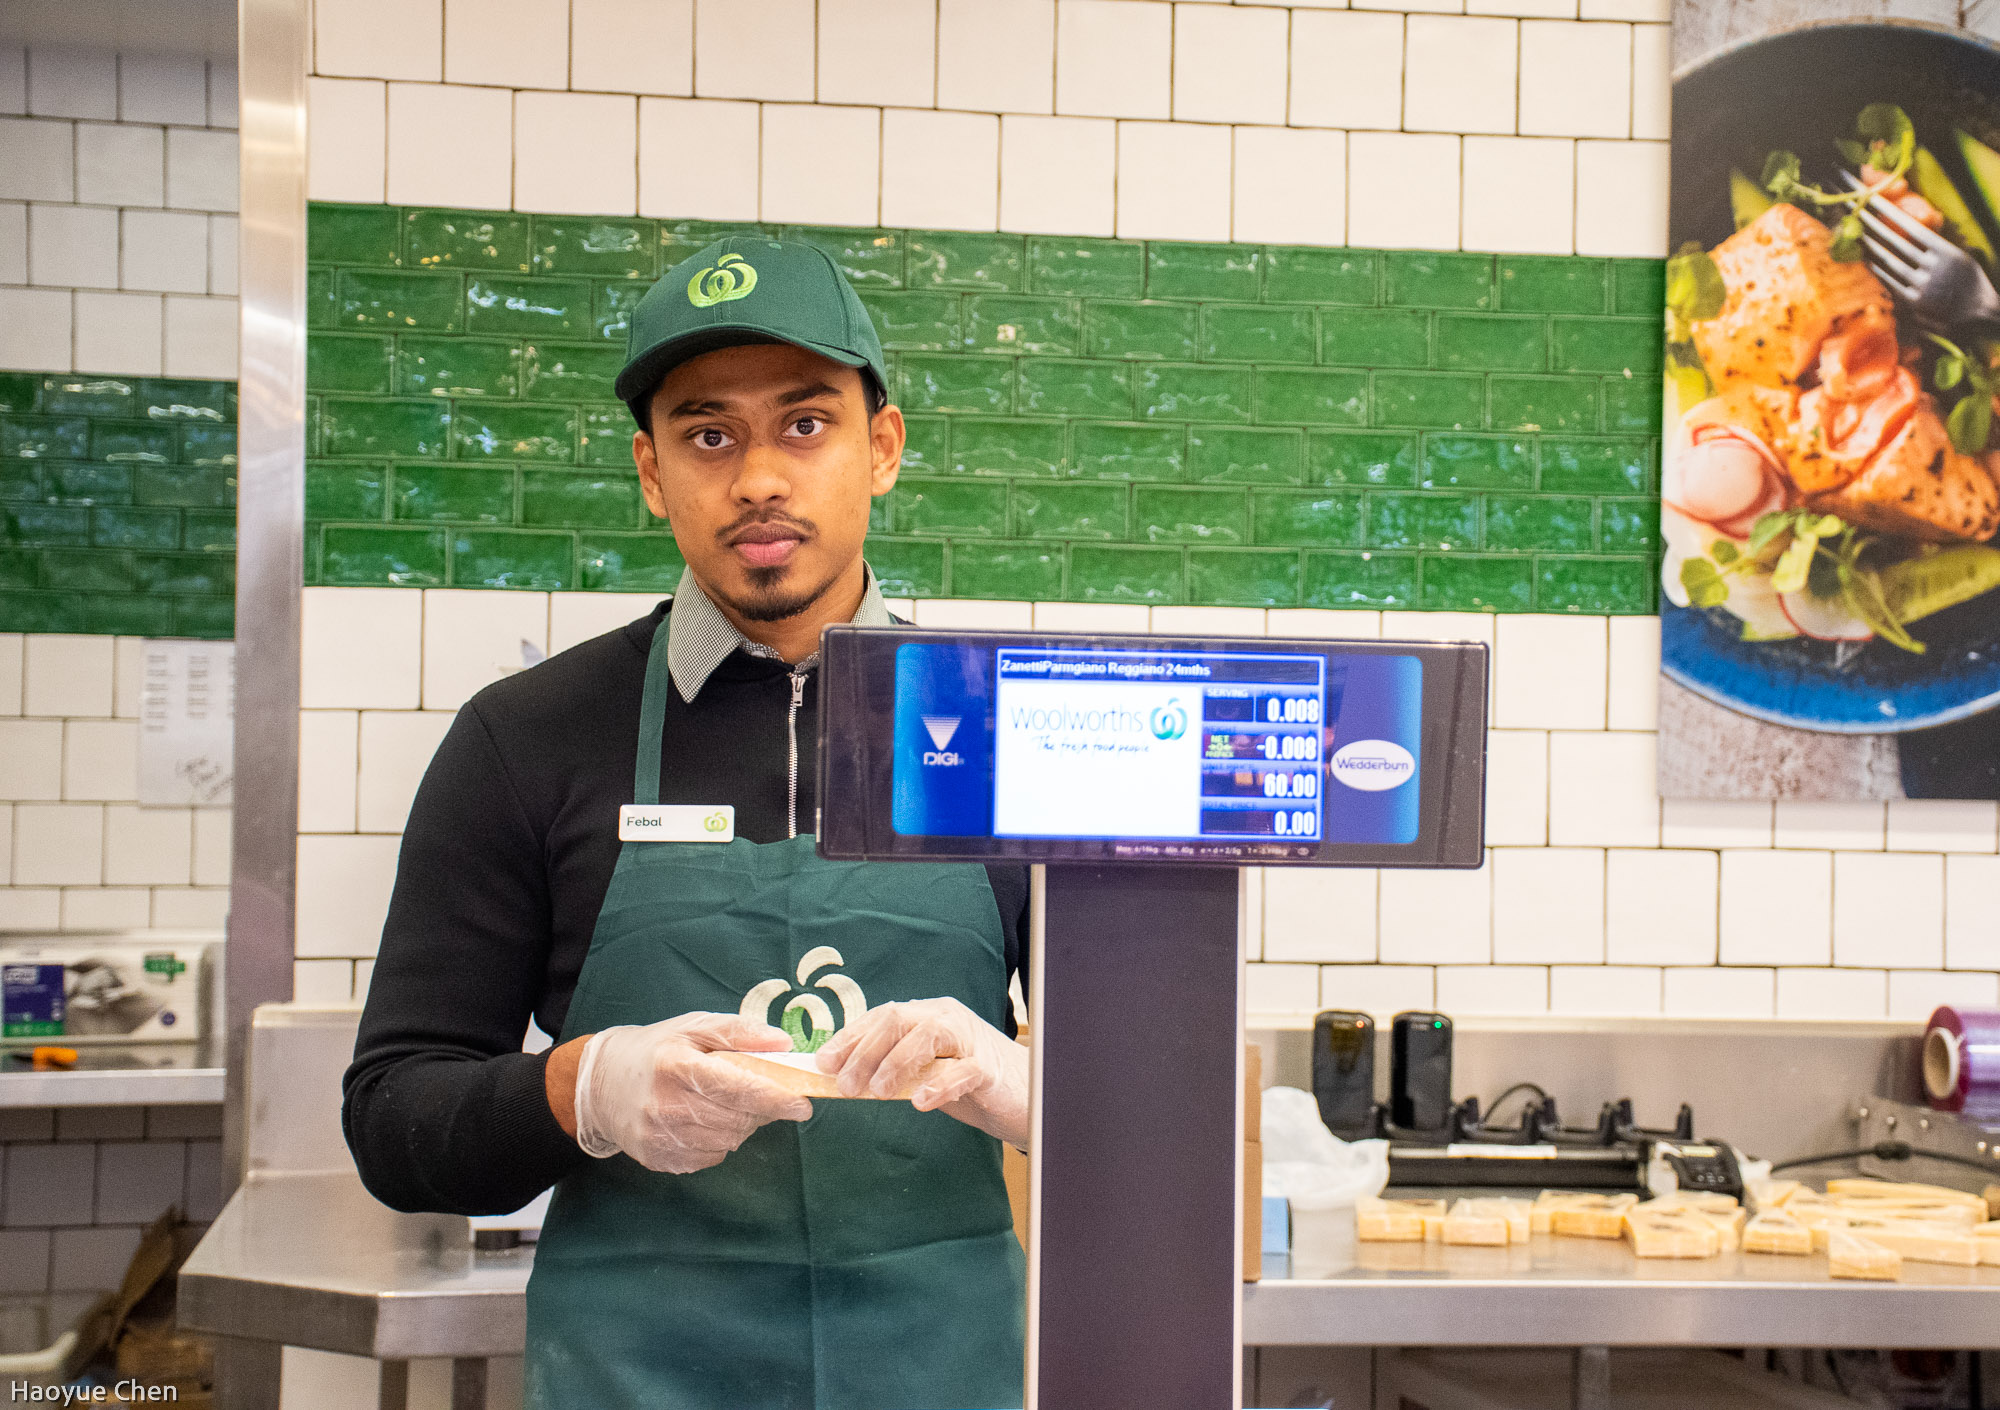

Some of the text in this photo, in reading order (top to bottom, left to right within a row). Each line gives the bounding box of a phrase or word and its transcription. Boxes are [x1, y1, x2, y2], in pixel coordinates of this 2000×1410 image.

[1108, 662, 1165, 677] Reggiano
[1166, 663, 1211, 676] 24mths
[1207, 688, 1249, 698] SERVING
[1011, 703, 1144, 731] Woolworths
[1267, 698, 1319, 722] 0.008
[1031, 735, 1055, 751] The
[1117, 739, 1150, 757] people
[1256, 736, 1317, 760] -0.008
[923, 752, 960, 767] DIGI
[1336, 757, 1409, 770] Wedderburn
[1264, 773, 1316, 797] 60.00
[626, 817, 662, 827] Febal
[1274, 811, 1315, 835] 0.00
